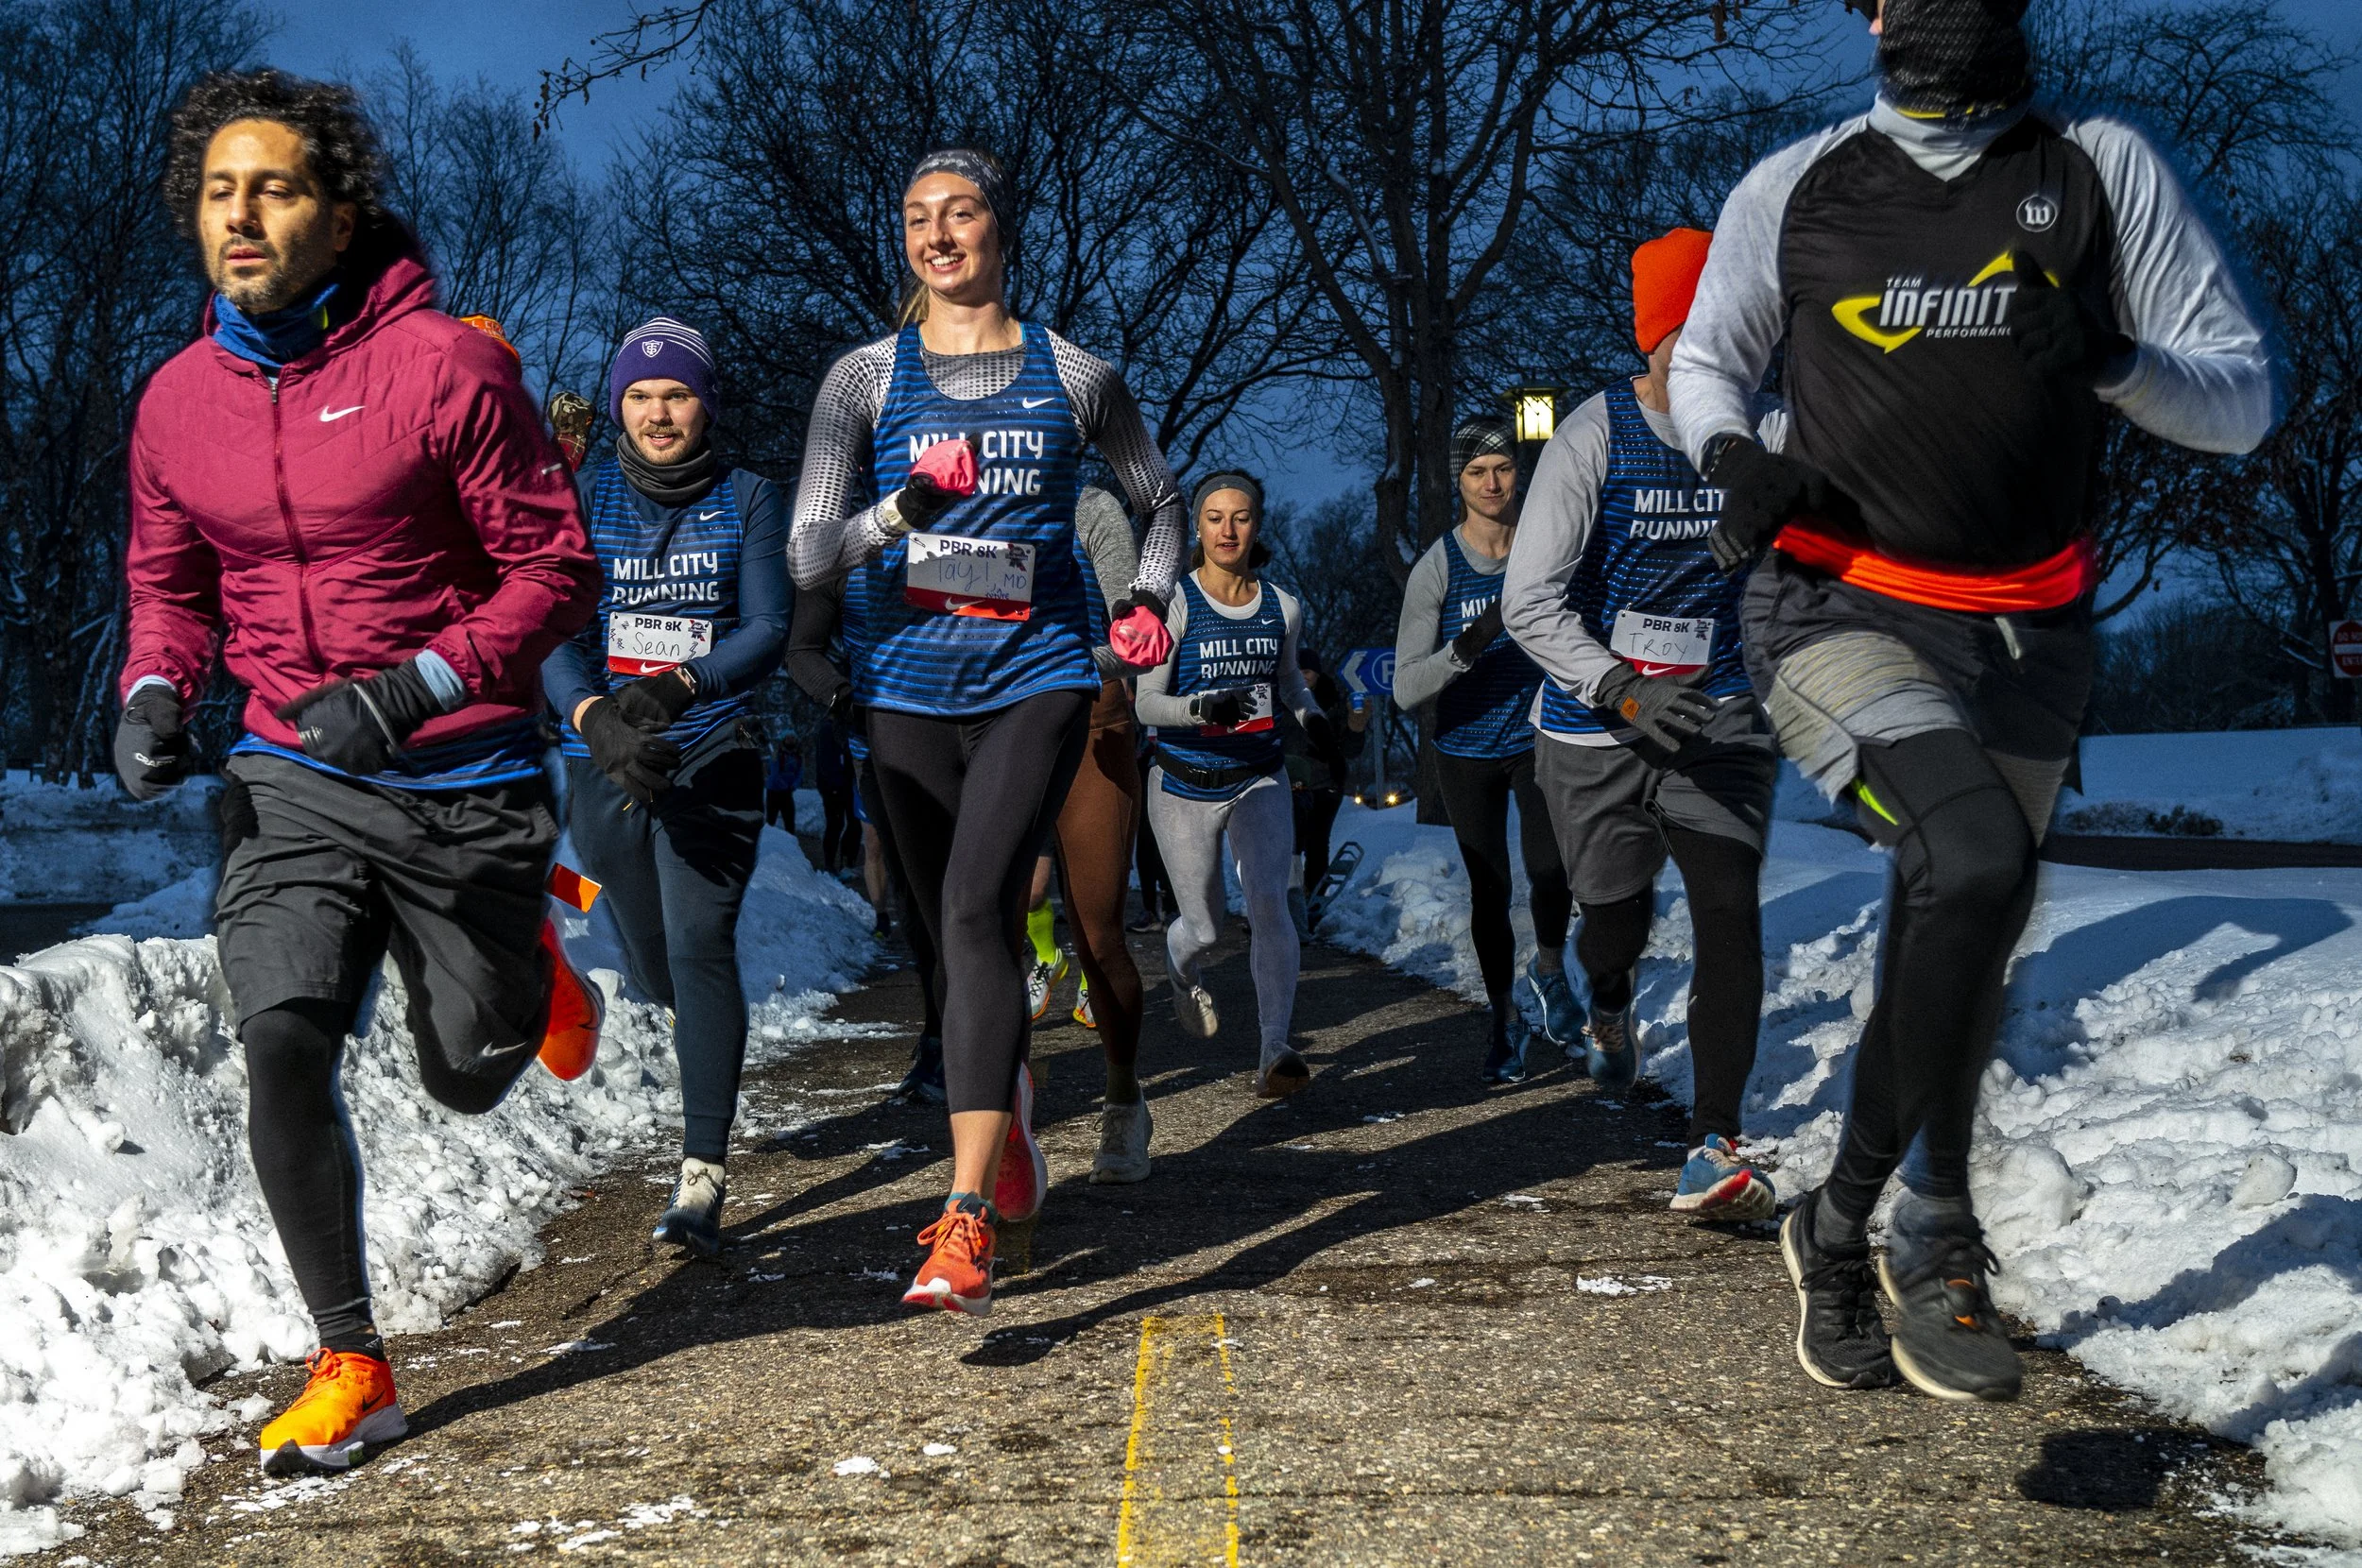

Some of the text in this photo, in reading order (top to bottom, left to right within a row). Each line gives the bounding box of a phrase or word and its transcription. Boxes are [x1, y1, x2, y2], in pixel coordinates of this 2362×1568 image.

[1886, 277, 1923, 288] TEAM
[1926, 326, 2011, 338] PERFORMAN
[983, 431, 1044, 460] CITY
[973, 469, 1041, 496] NING
[1634, 488, 1724, 513] MILL CIT
[1629, 519, 1718, 541] RUNNI
[940, 539, 972, 556] PBR
[977, 545, 997, 559] 8K
[613, 552, 718, 581] MILL CITY
[1004, 573, 1027, 589] MD
[611, 581, 720, 605] RUNNING
[635, 617, 661, 631] PBR
[665, 621, 682, 632] 8K
[1643, 618, 1690, 633] PBR 8K
[632, 631, 680, 657] Sean
[1199, 638, 1277, 659] MILL CITY
[1629, 632, 1688, 664] TROY
